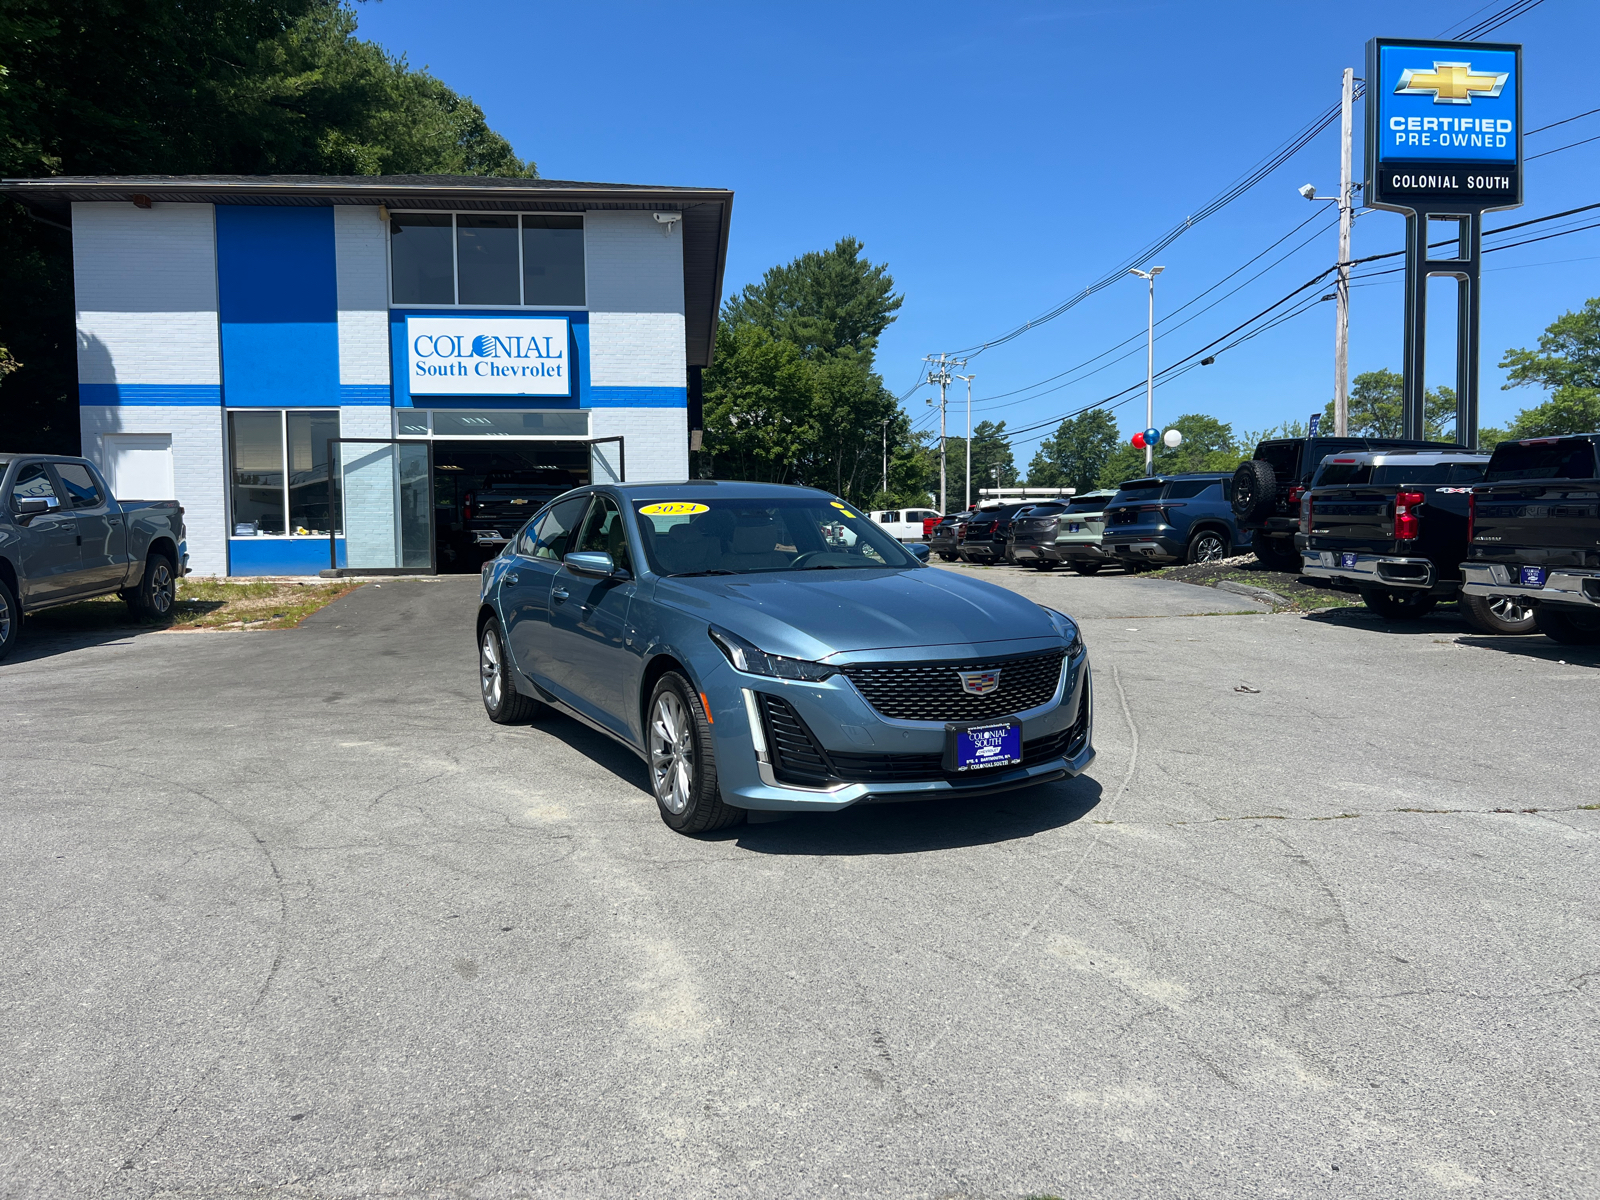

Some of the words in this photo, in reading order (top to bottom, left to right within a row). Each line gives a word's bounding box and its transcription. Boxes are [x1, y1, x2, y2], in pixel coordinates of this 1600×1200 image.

[1390, 116, 1512, 133] CERTIFIED
[1396, 133, 1507, 148] PRE-OWNED
[1392, 174, 1459, 188] COLONIAL
[1467, 175, 1509, 189] SOUTH
[414, 334, 563, 358] COLONIAL
[415, 360, 468, 377] South
[474, 361, 563, 377] Chevrolet
[652, 505, 697, 514] 2024
[969, 729, 1008, 741] COLONIAL
[974, 737, 1002, 748] SOUTH
